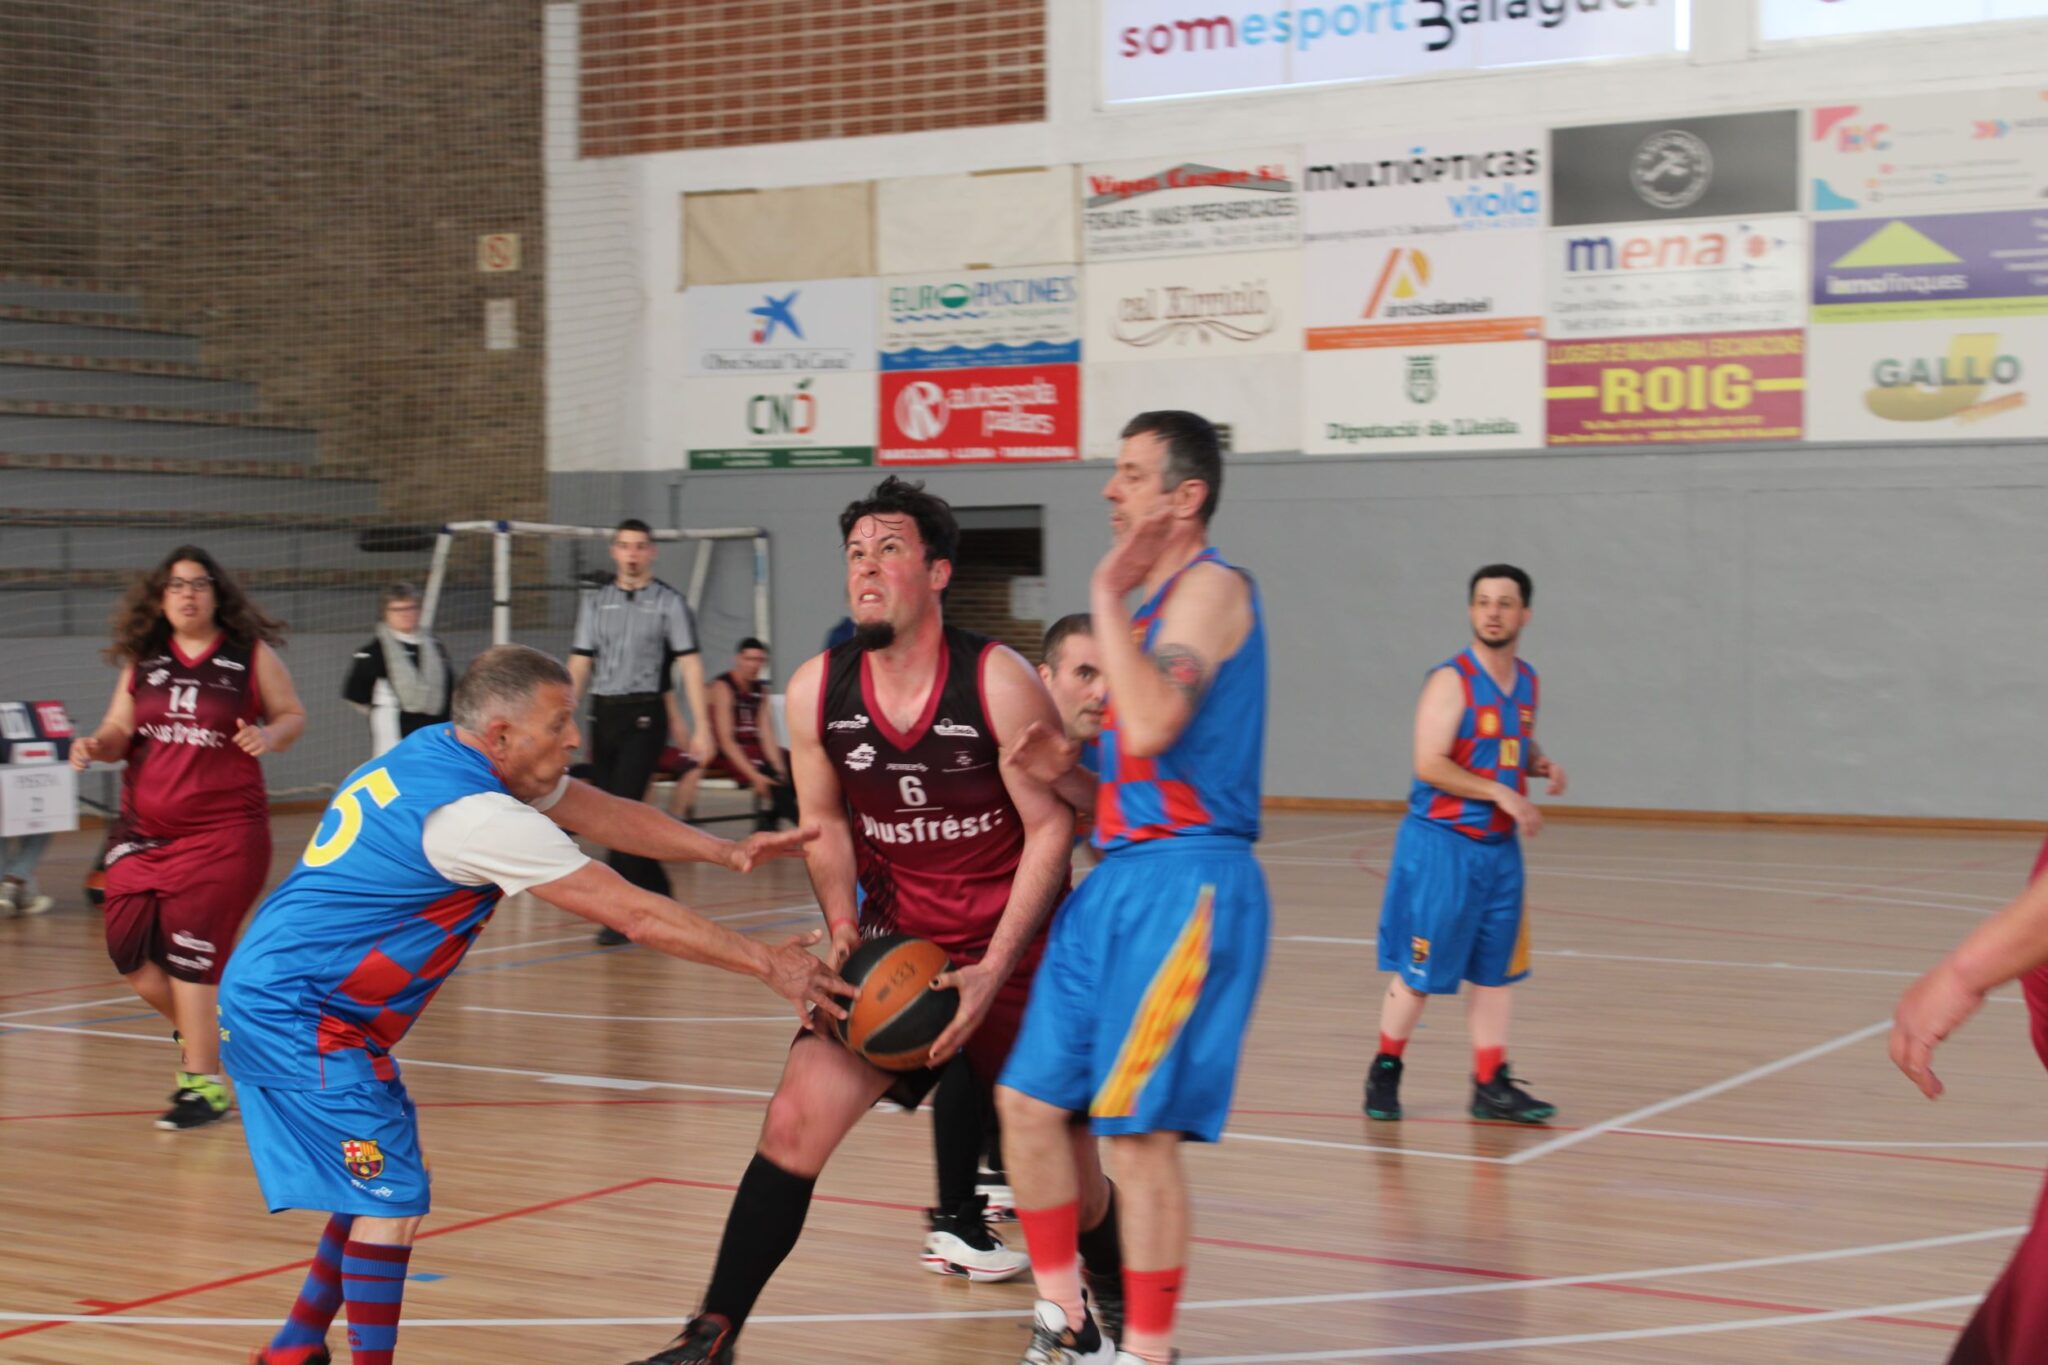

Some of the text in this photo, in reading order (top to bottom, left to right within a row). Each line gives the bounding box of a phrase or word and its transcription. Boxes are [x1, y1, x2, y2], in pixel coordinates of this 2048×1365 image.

[1447, 182, 1540, 218] viola
[1565, 230, 1729, 273] mena
[1601, 362, 1753, 414] ROIG
[1872, 353, 2023, 388] GALLO
[168, 685, 199, 714] 14
[898, 775, 928, 807] 6
[302, 766, 401, 867] 5
